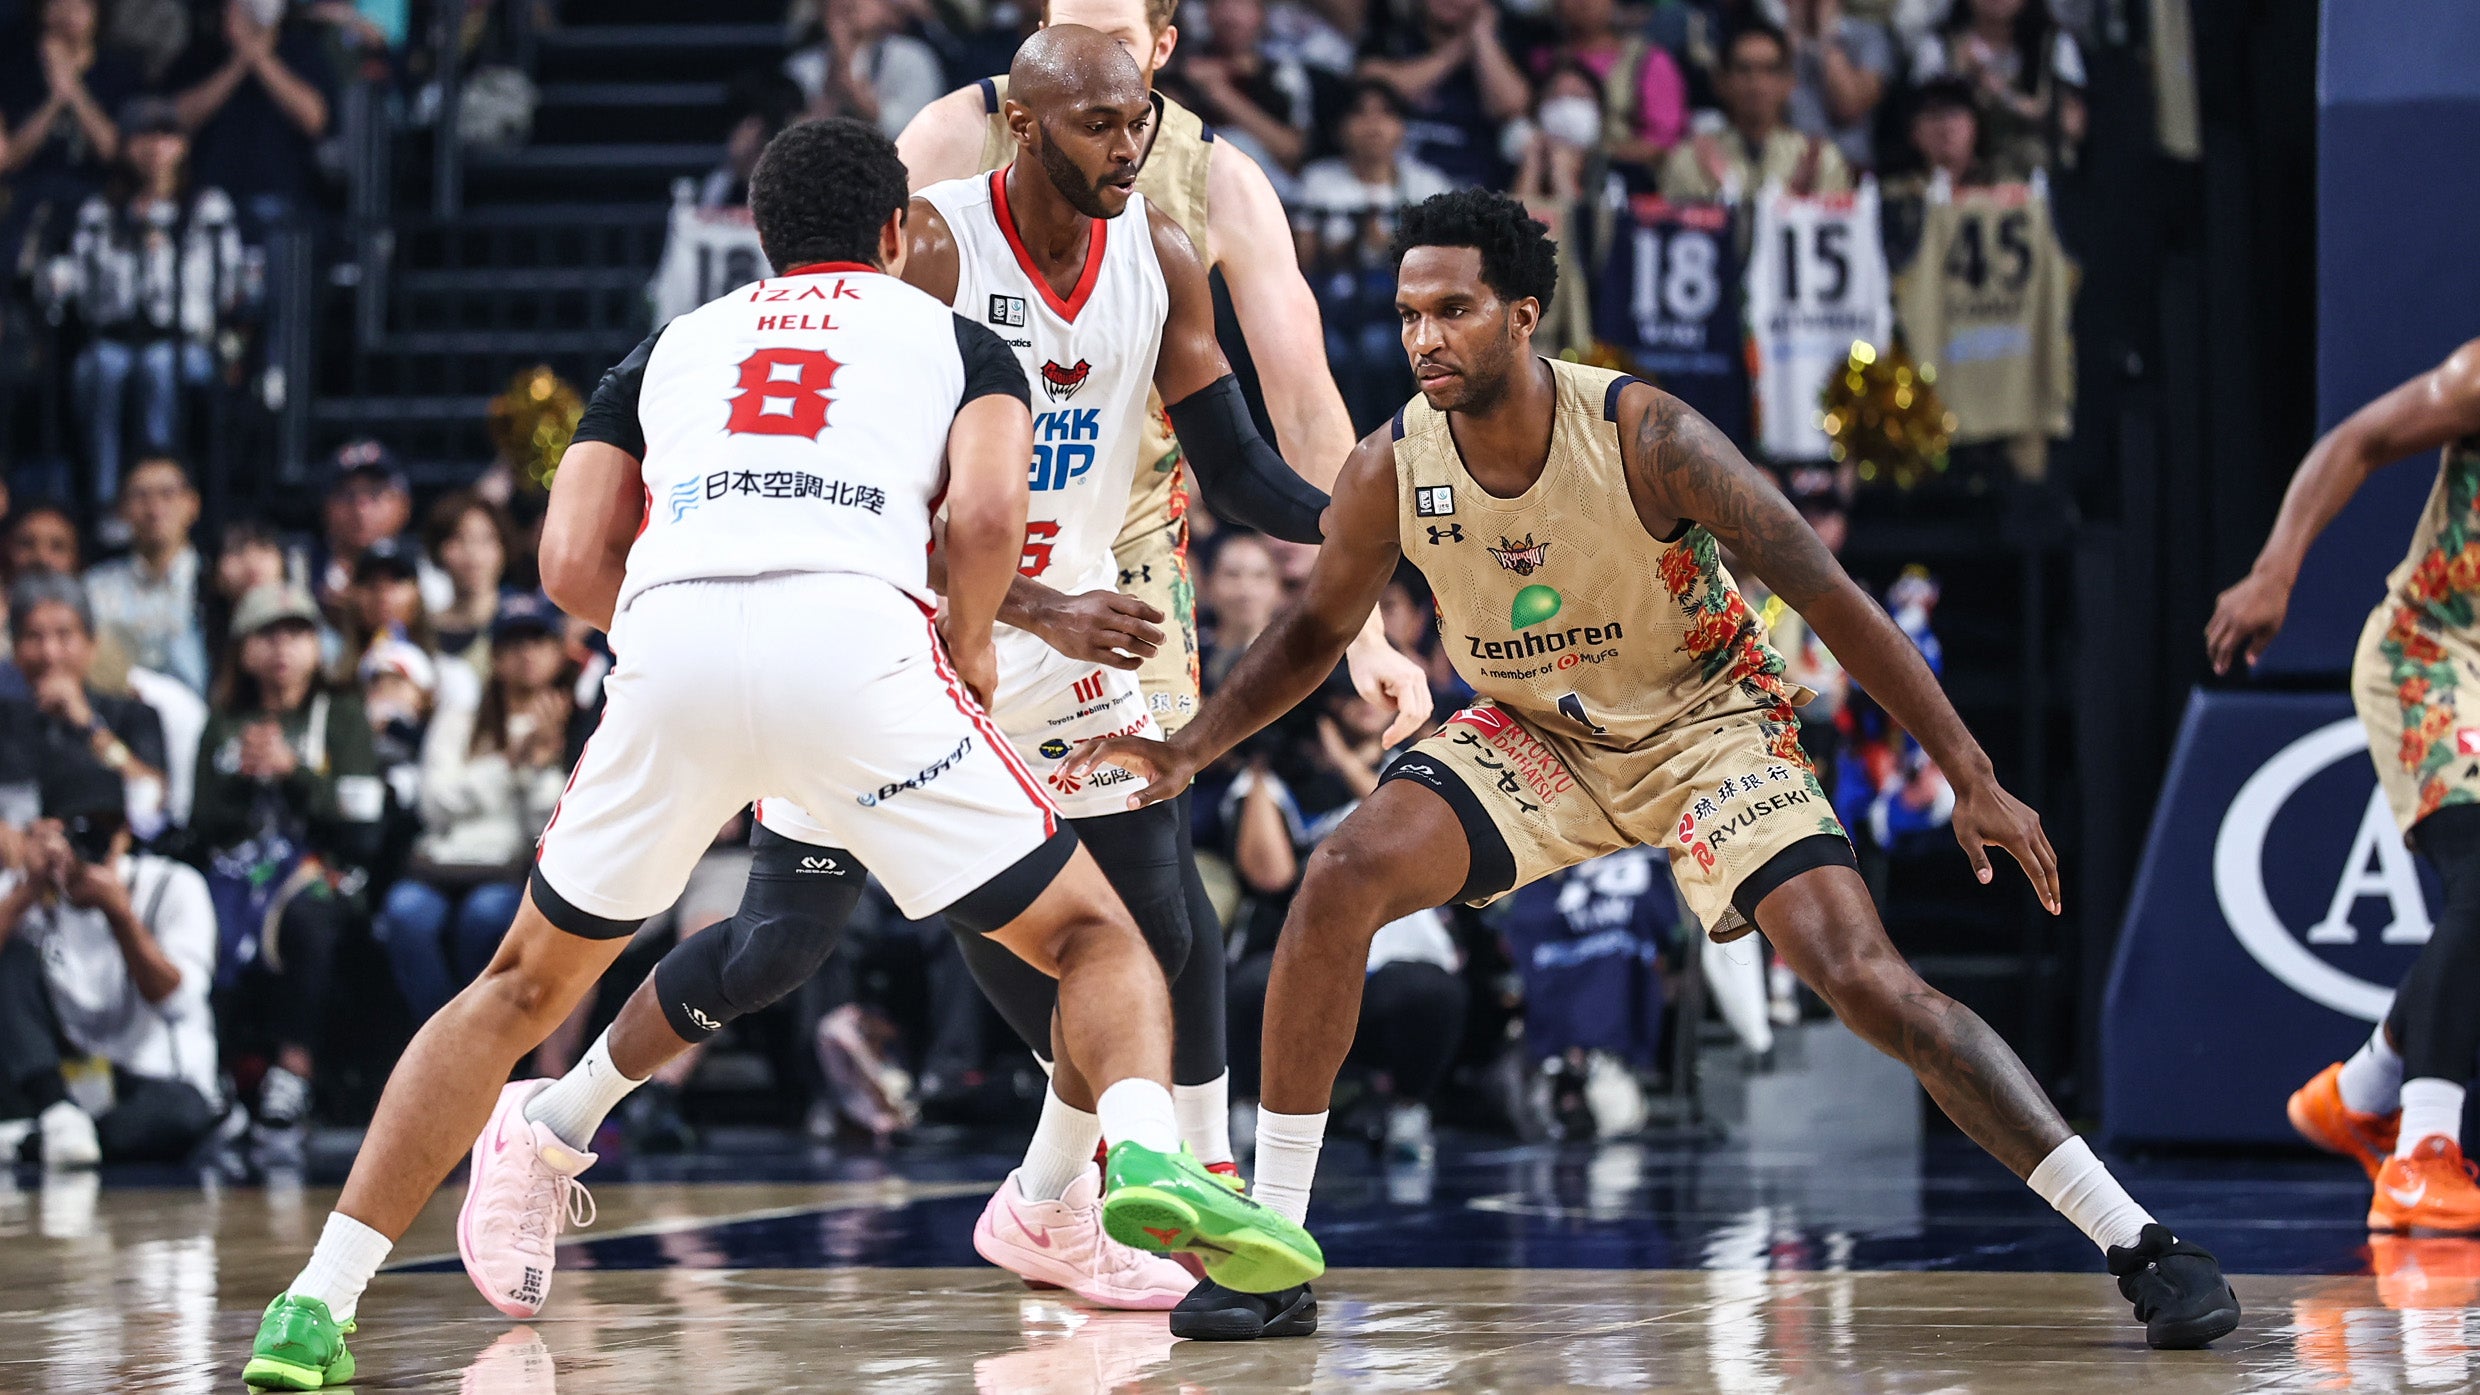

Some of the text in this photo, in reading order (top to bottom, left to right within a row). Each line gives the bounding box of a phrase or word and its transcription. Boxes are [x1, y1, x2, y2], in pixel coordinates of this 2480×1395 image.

[1631, 226, 1721, 326] 18
[1782, 224, 1850, 302] 15
[1944, 212, 2032, 290] 45
[722, 347, 848, 442] 8
[706, 469, 886, 515] 日本空調北陸
[1465, 622, 1624, 660] Zenhoren
[1480, 648, 1619, 681] A member of MUFG
[1047, 715, 1075, 726] Toyota
[1076, 702, 1110, 719] Mobility
[1452, 730, 1539, 814] ナンセイ
[1493, 735, 1556, 805] DAIHATSU
[1505, 722, 1575, 794] RYUKYU
[1694, 766, 1790, 821] 琉球銀行
[1708, 789, 1811, 850] RYUSEKI
[2306, 780, 2435, 945] A
